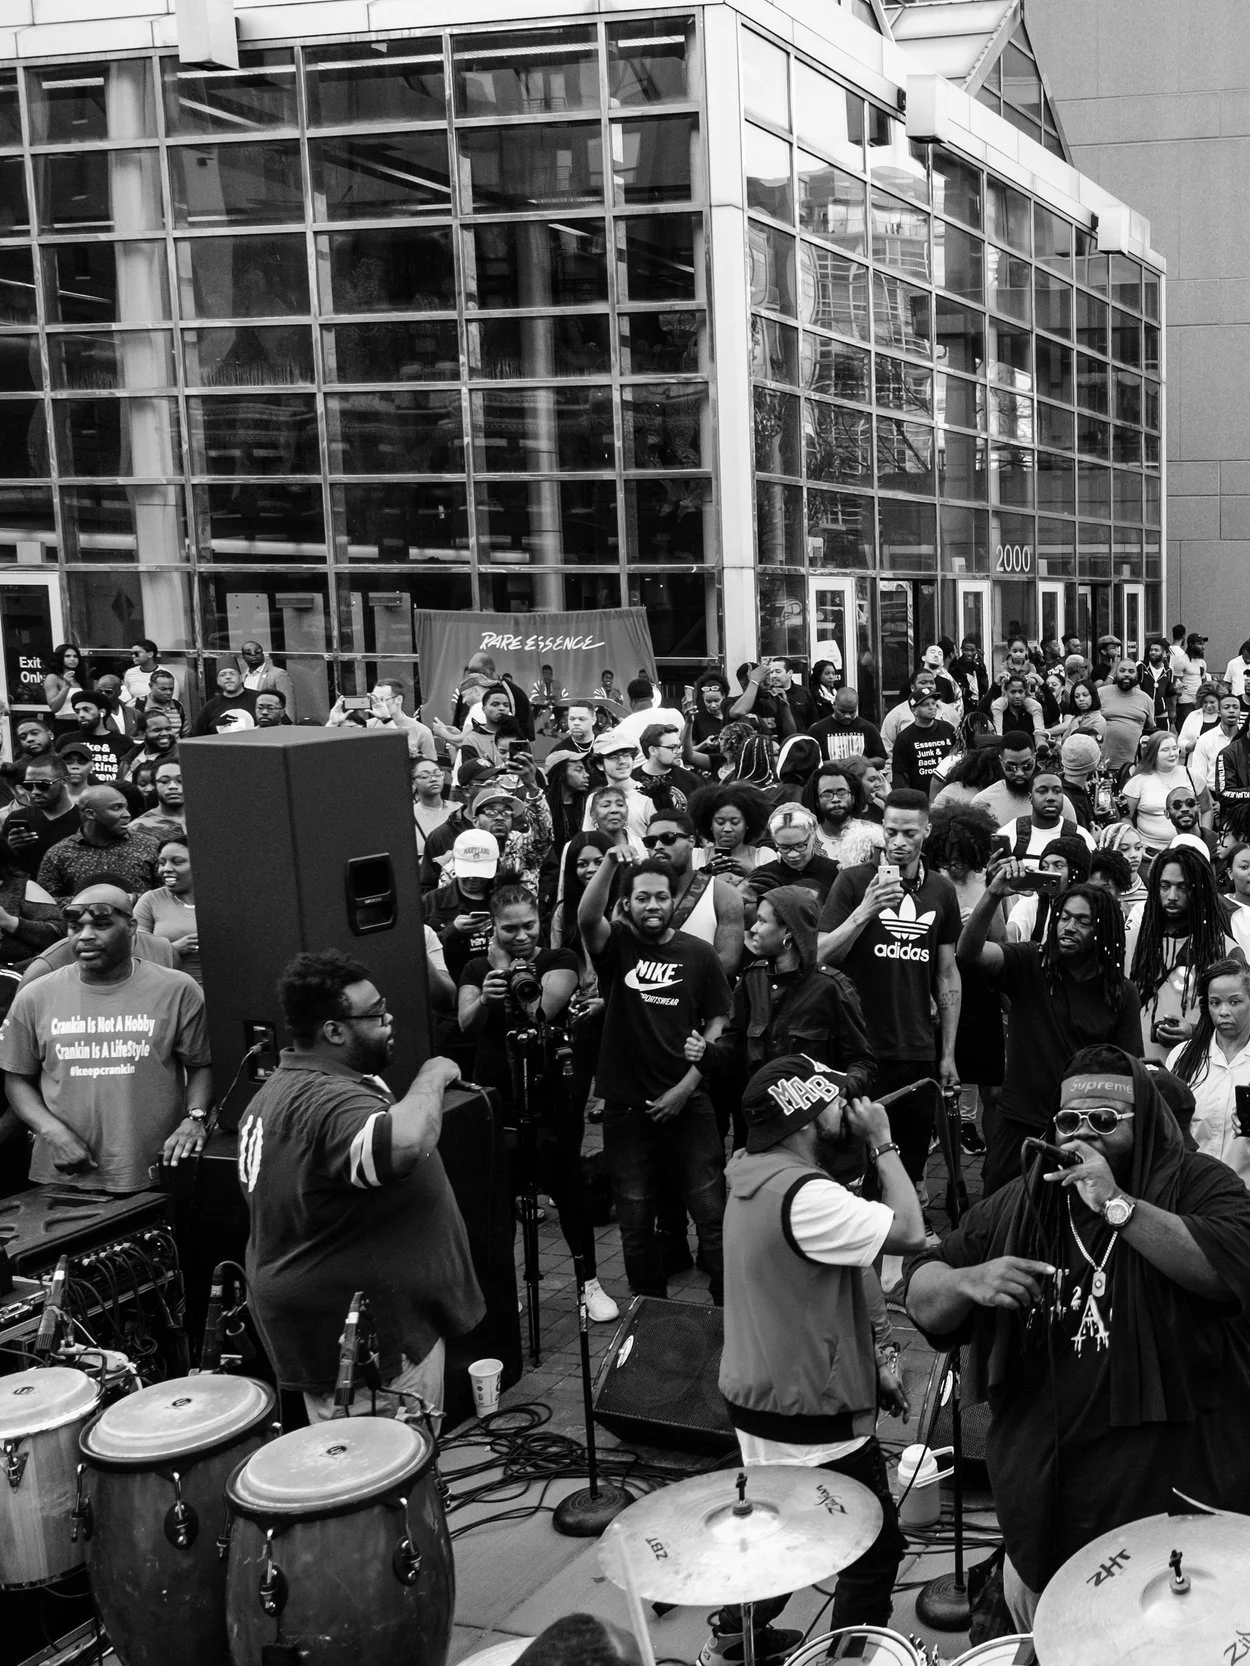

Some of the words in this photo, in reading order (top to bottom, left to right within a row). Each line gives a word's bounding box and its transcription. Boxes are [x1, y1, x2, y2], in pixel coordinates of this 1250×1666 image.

[996, 544, 1030, 572] 2000
[479, 631, 522, 650] RARE
[524, 635, 605, 652] ESSENCE
[19, 656, 42, 669] Exit
[914, 740, 945, 750] Essence
[946, 738, 952, 746] &
[917, 749, 934, 758] Junk
[936, 748, 942, 756] &
[92, 753, 117, 763] as&
[918, 758, 937, 767] Back
[874, 941, 930, 962] adidas
[636, 959, 678, 983] NIKE
[51, 1015, 86, 1035] Crankin
[87, 1016, 97, 1033] Is
[98, 1016, 115, 1032] Not
[116, 1015, 124, 1032] A
[125, 1014, 156, 1037] Hobby
[55, 1040, 90, 1060] Crankin
[92, 1042, 100, 1059] Is
[101, 1041, 110, 1058] A
[111, 1040, 150, 1061] LifeStyle
[70, 1063, 136, 1078] #keepcrankin
[1070, 1079, 1133, 1094] Supreme
[645, 1536, 669, 1560] ZBT
[1086, 1548, 1131, 1586] ZHT
